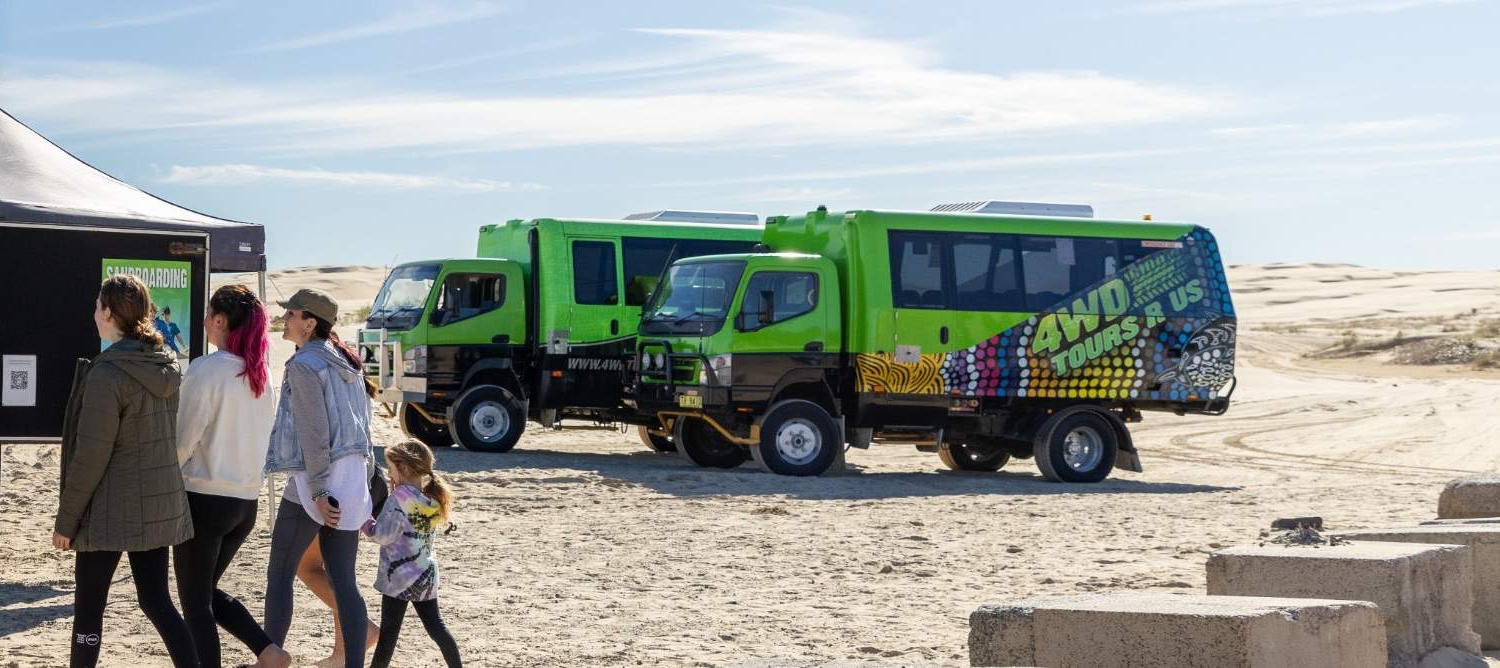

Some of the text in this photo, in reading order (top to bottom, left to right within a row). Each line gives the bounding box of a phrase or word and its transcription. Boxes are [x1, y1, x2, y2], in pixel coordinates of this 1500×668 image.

[1032, 278, 1130, 355] 4WD
[1052, 279, 1204, 376] TOURS R US
